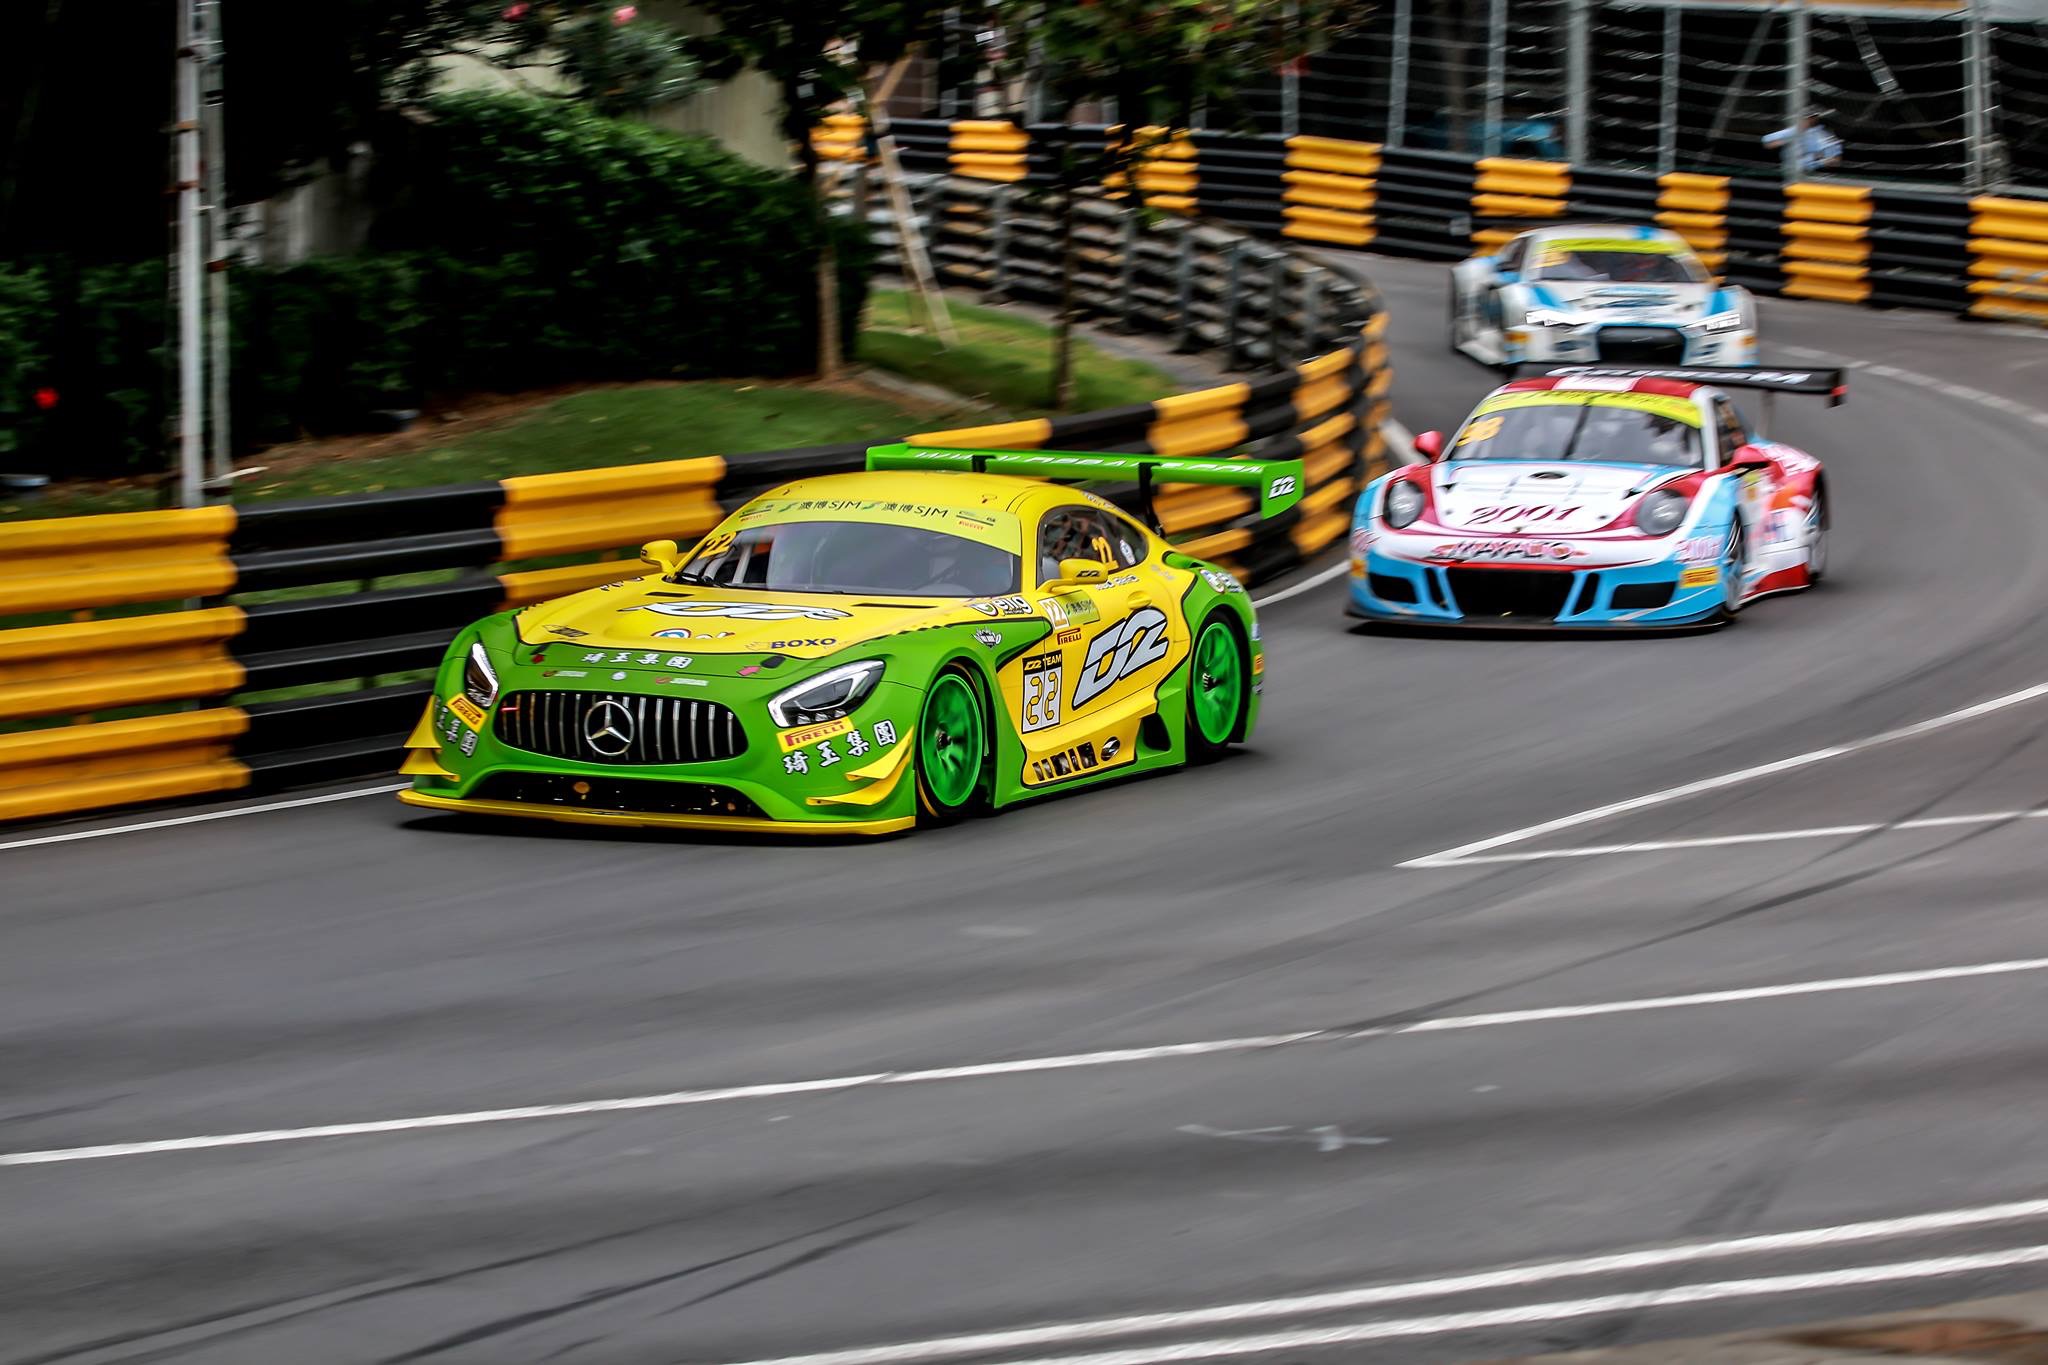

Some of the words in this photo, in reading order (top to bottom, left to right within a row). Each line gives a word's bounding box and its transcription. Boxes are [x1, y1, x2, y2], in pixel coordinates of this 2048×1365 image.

[1268, 475, 1296, 500] D2
[1464, 504, 1584, 527] 2001
[697, 531, 737, 560] 22
[770, 637, 837, 650] BOXO
[1057, 627, 1082, 645] PIRELLI
[1023, 659, 1043, 671] D2
[1043, 653, 1062, 667] TEAM
[1072, 606, 1169, 711] D2
[1024, 671, 1060, 726] 22
[784, 720, 846, 747] PIRELLI
